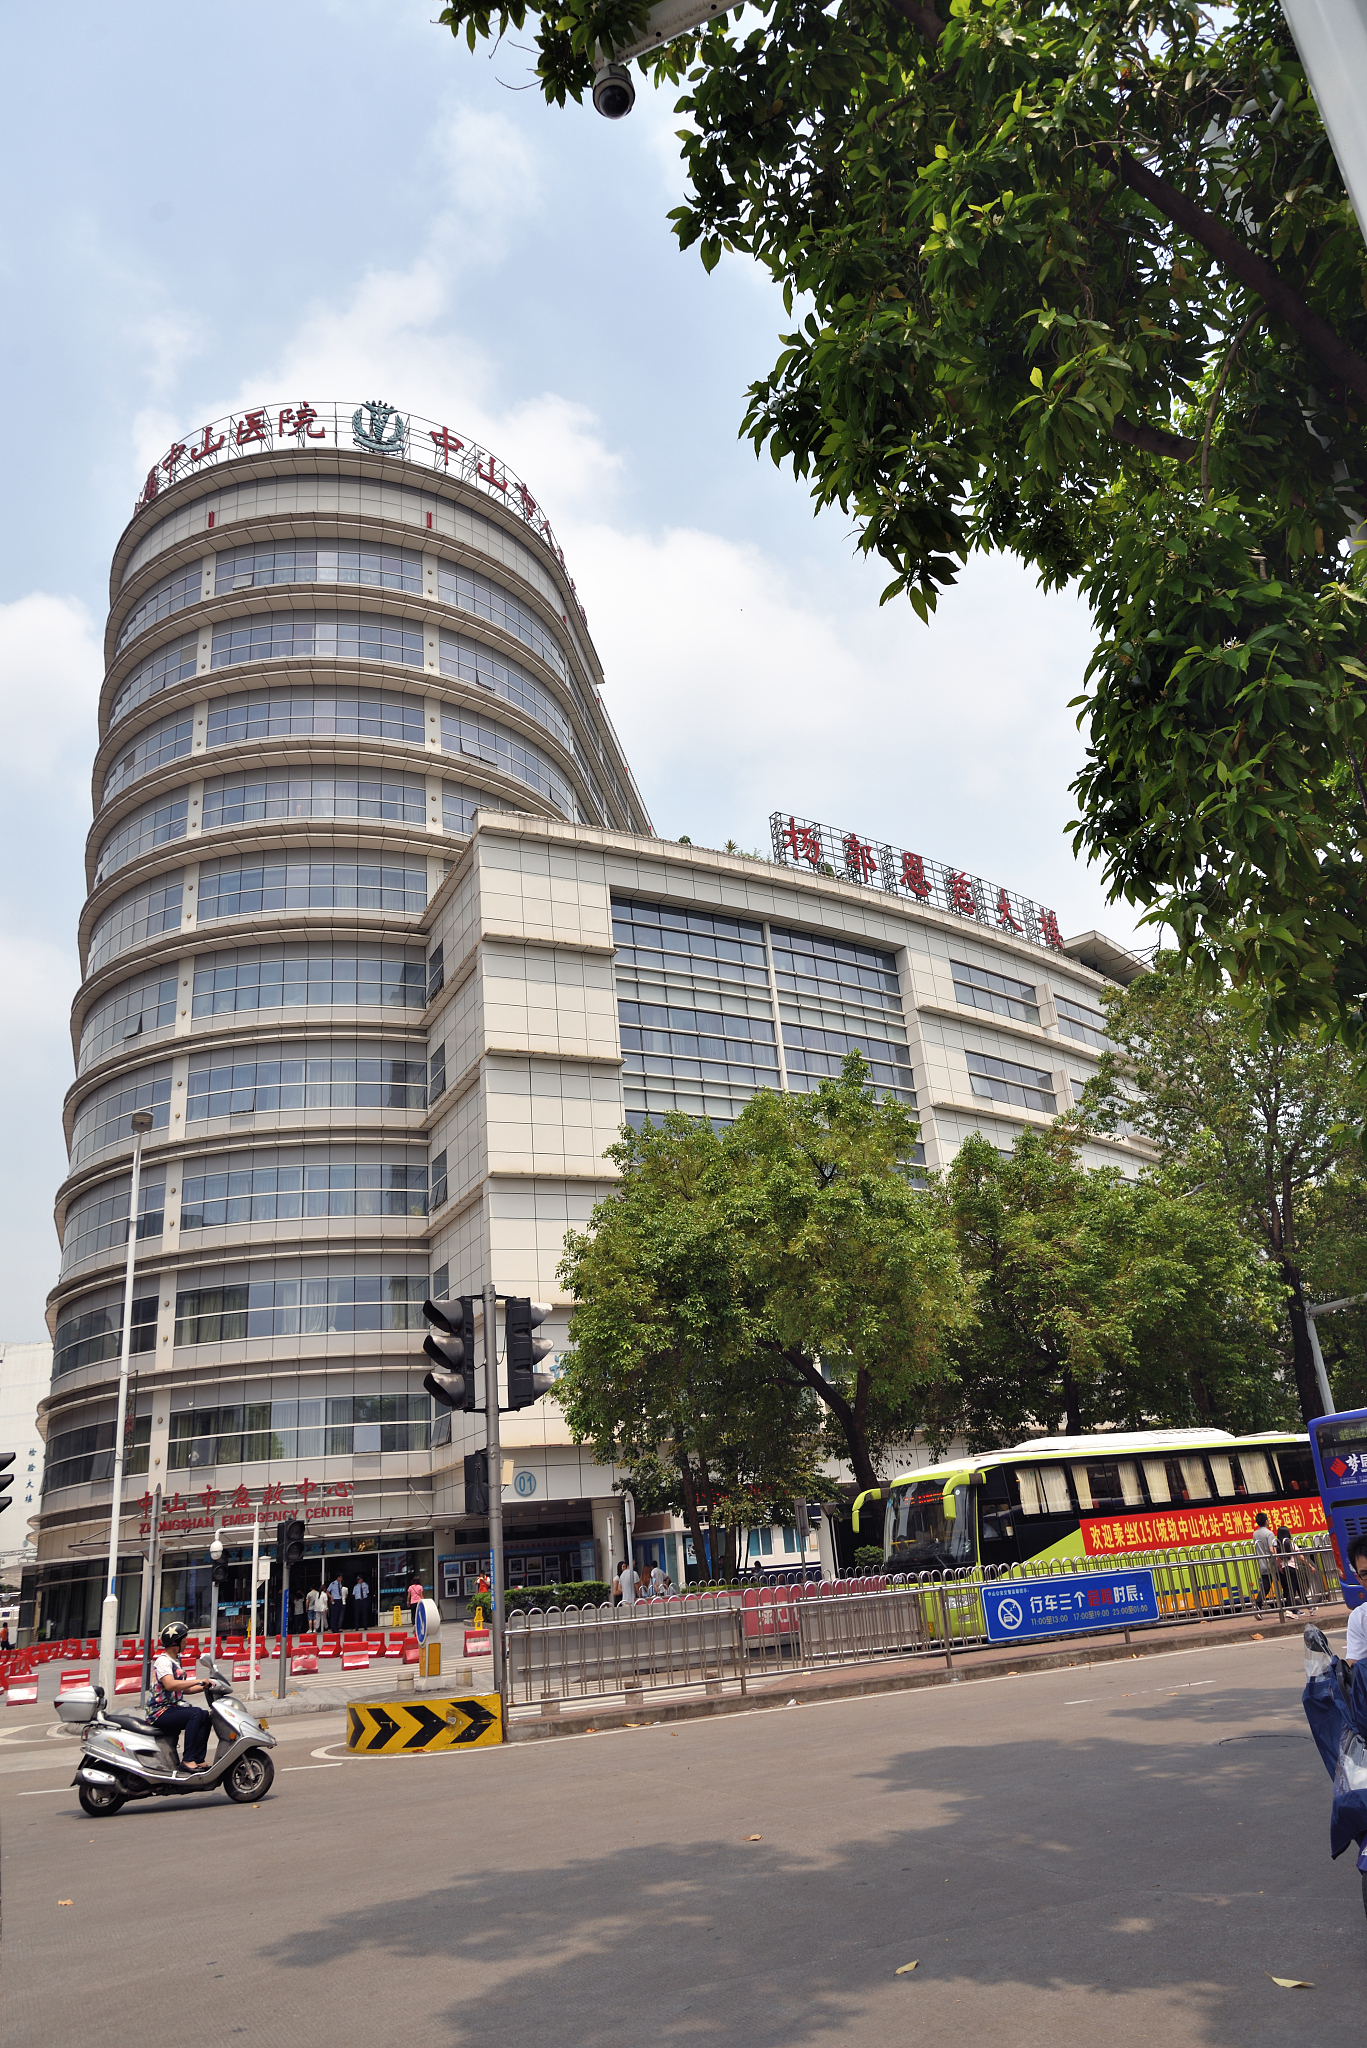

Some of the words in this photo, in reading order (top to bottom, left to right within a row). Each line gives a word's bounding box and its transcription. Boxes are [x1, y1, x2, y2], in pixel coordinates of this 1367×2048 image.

[144, 401, 326, 504] 中山医院
[784, 817, 1063, 948] 杨郭恩慈大楼
[138, 1478, 354, 1519] 中山市急救中心
[518, 1475, 533, 1492] 01
[221, 1509, 299, 1527] EMERGENCY
[305, 1505, 353, 1519] CENTRE
[1031, 1614, 1068, 1626] 11:00至13:00
[1073, 1609, 1109, 1621] 17:00至19:00
[1112, 1604, 1149, 1617] 23:00至01:00
